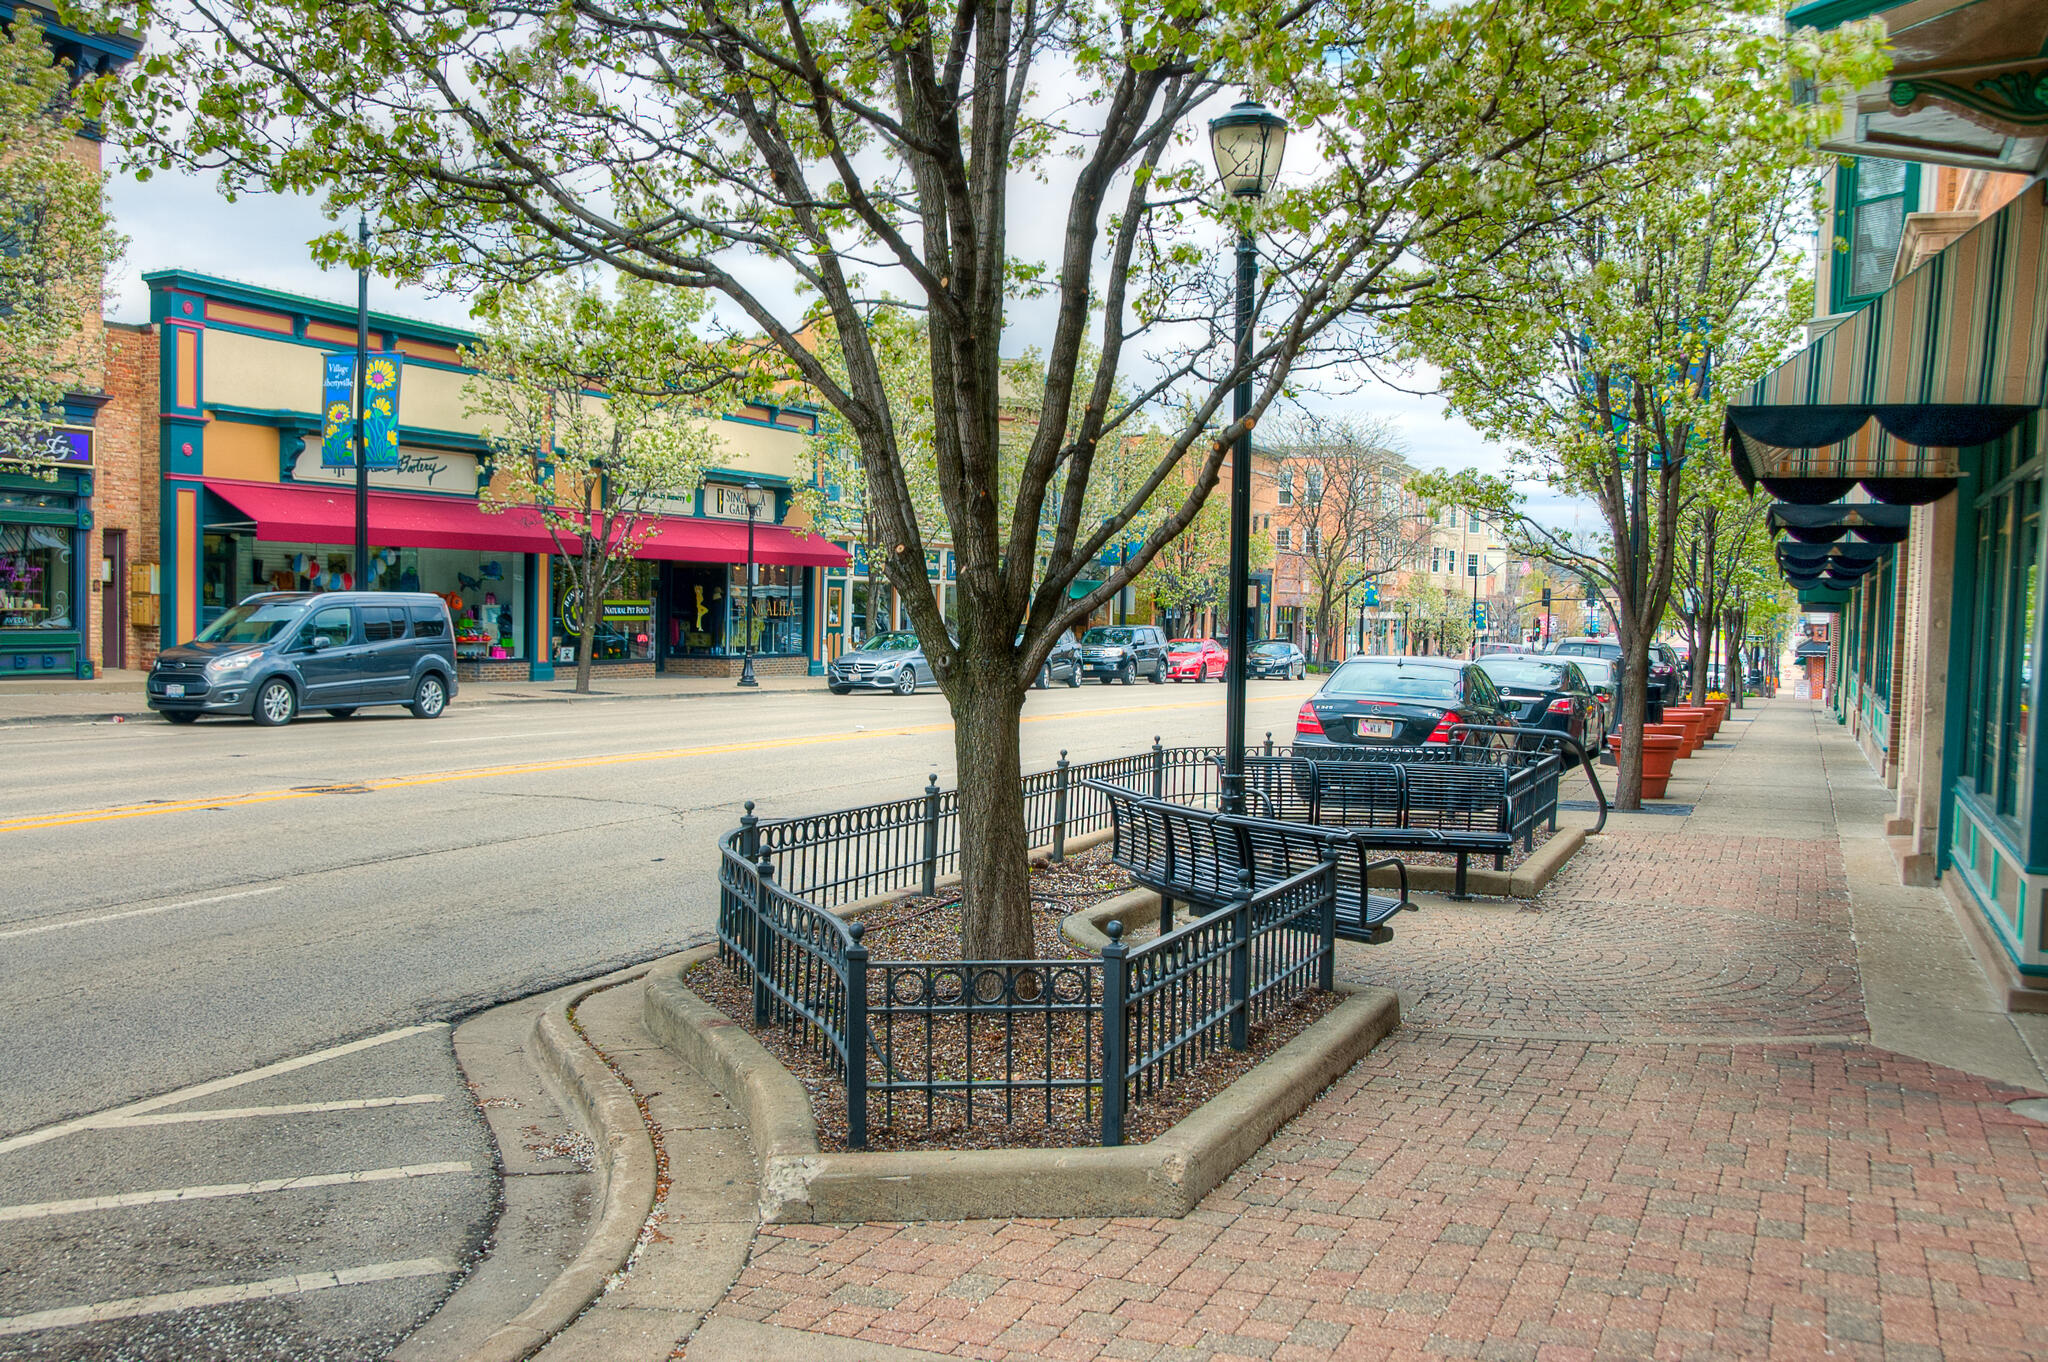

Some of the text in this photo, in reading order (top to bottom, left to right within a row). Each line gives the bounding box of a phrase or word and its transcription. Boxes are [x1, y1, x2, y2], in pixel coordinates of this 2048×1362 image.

[328, 363, 349, 376] Village
[398, 454, 447, 486] Bootery
[726, 490, 766, 506] SINGA
